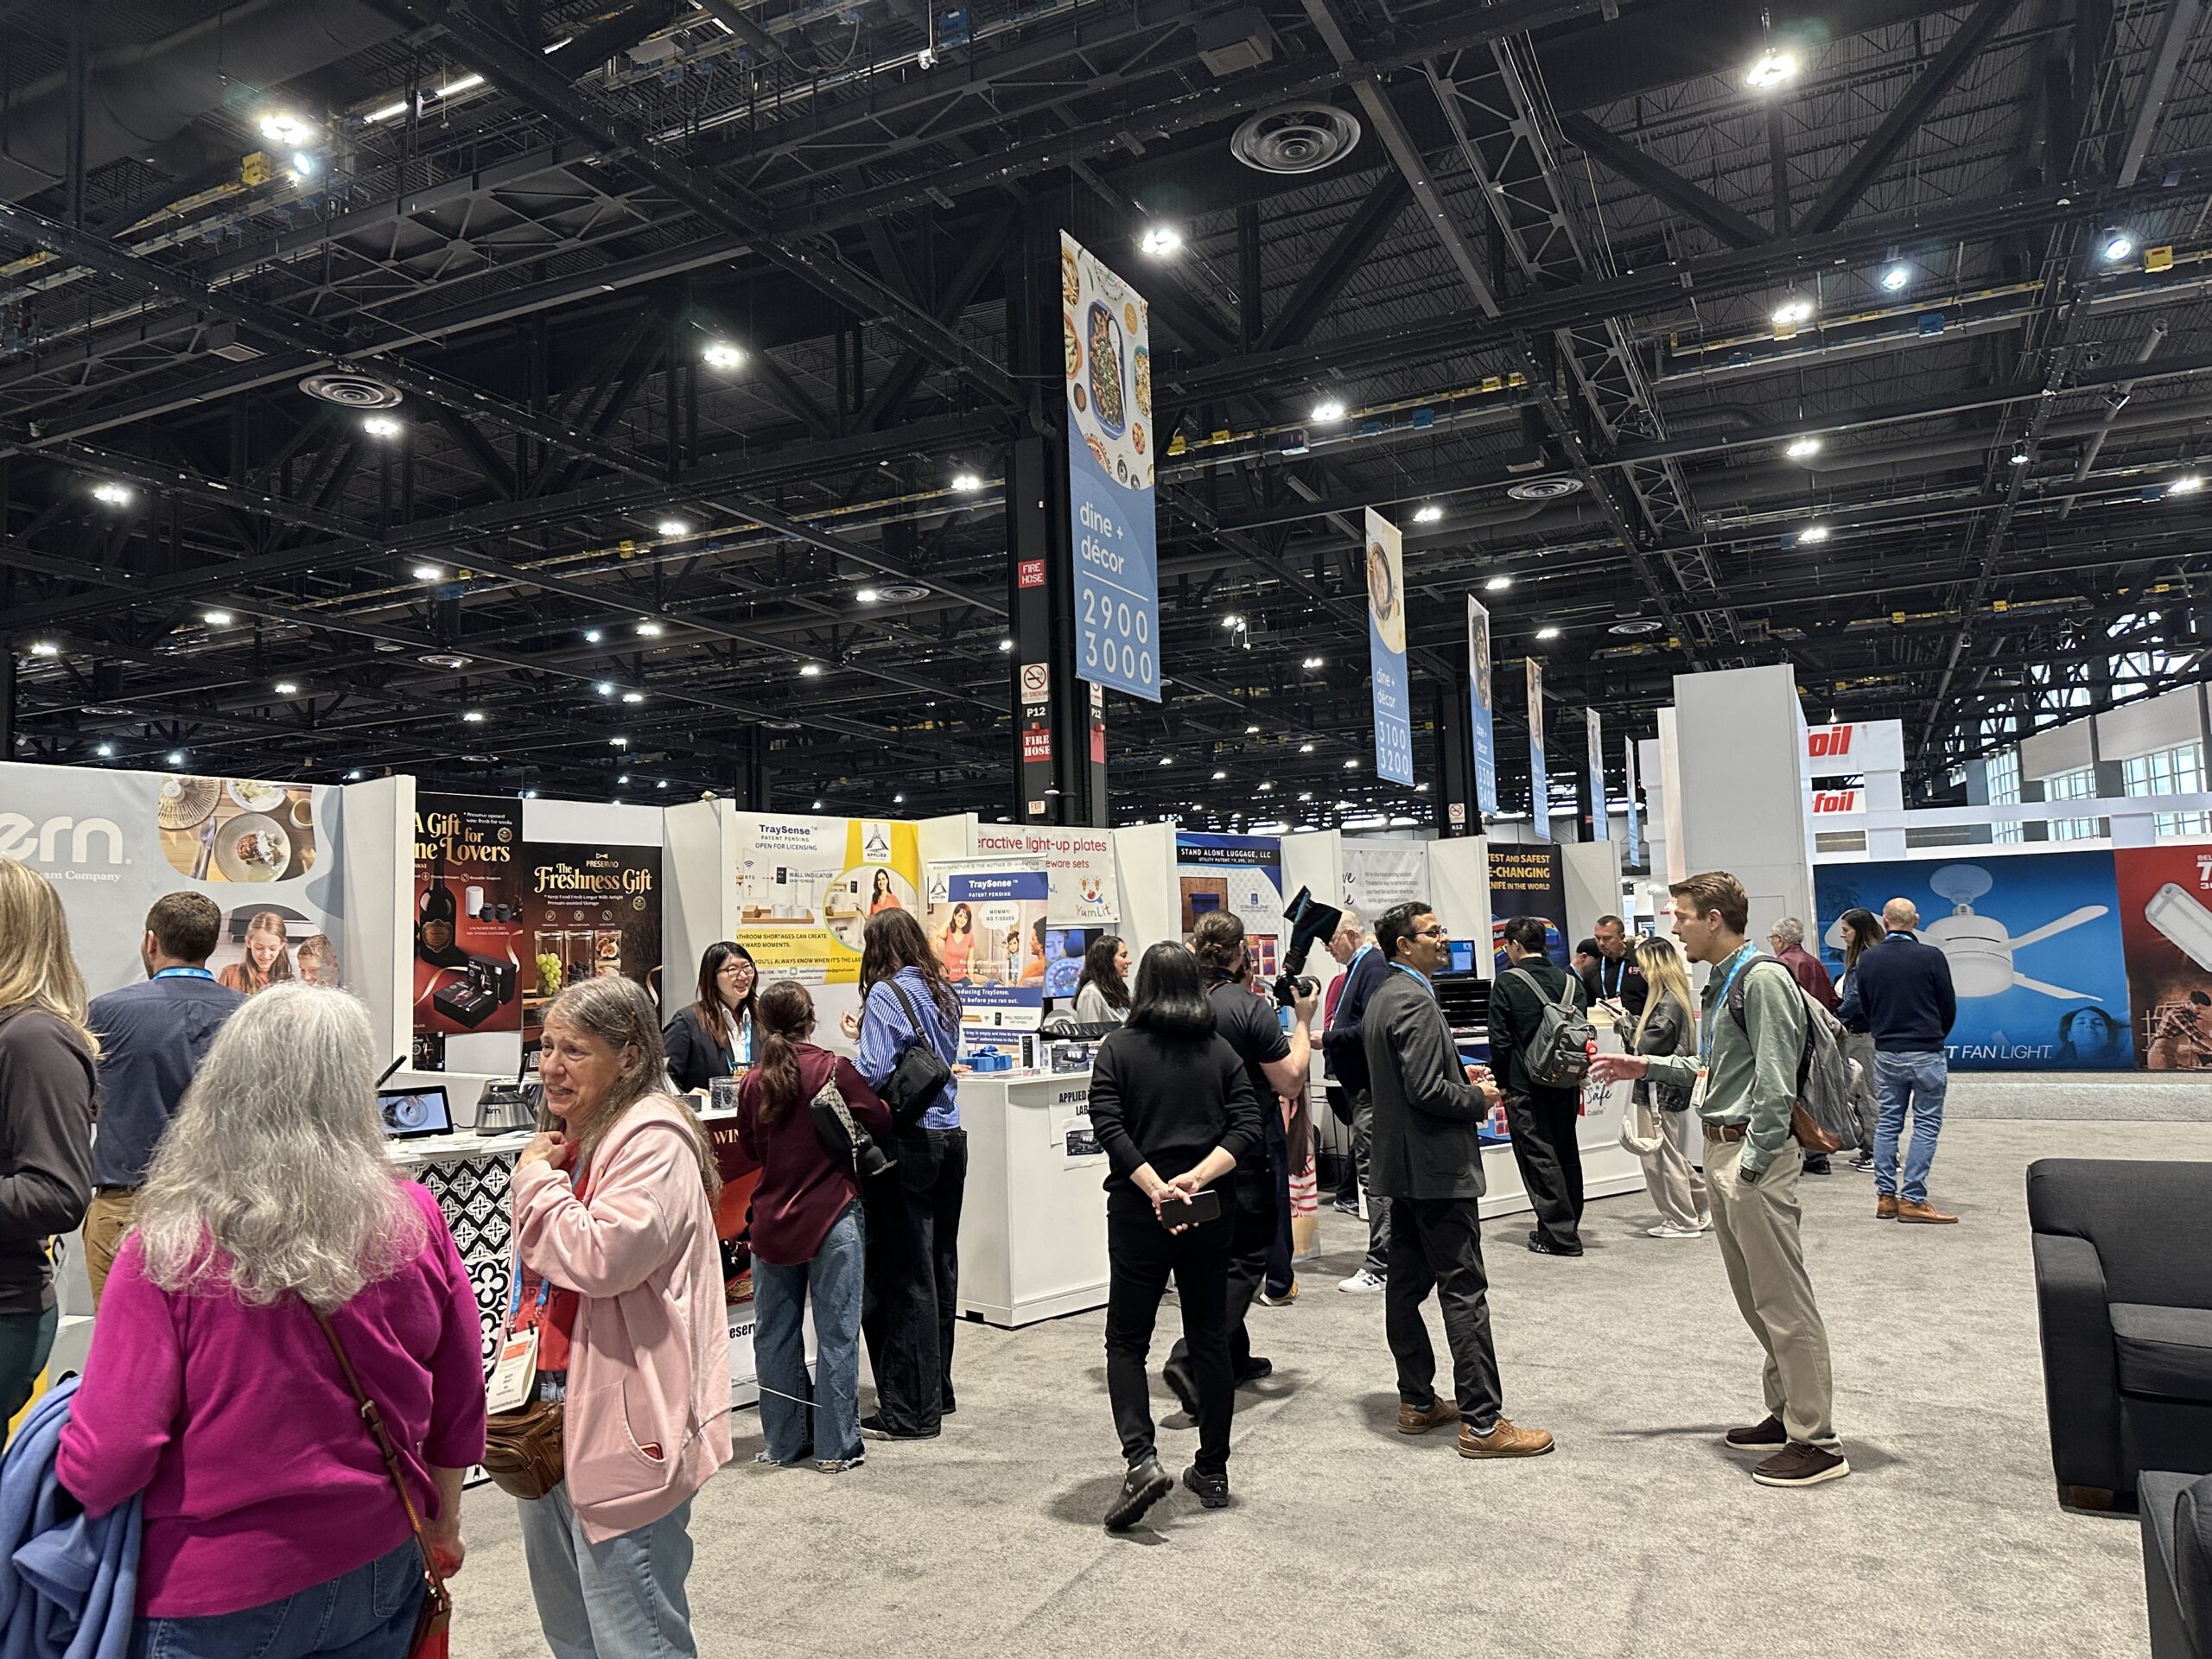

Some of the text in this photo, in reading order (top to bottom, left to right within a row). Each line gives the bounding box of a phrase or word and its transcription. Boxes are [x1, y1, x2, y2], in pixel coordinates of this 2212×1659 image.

[1080, 501, 1113, 538] dine
[1081, 535, 1125, 575] décor
[1023, 563, 1040, 574] FIRE
[1021, 573, 1043, 584] HOSE
[1083, 588, 1148, 645] 2900
[1085, 630, 1153, 685] 3000
[1376, 668, 1390, 687] dine
[1377, 689, 1396, 709] décor
[1027, 707, 1046, 717] P12
[1091, 708, 1102, 719] P12
[1025, 734, 1049, 746] FIRE
[1379, 720, 1406, 751] 3100
[1808, 725, 1853, 757] oil
[1024, 745, 1051, 757] HOSE
[1380, 747, 1408, 776] 3200
[1813, 791, 1855, 813] foil
[427, 812, 461, 838] Gift
[759, 824, 810, 835] TraySense
[465, 827, 484, 842] for
[439, 836, 511, 866] Lovers
[1027, 836, 1070, 853] light-up
[1073, 838, 1107, 854] plates
[1227, 850, 1258, 859] LUGGAGE,
[1521, 855, 1550, 863] SAFEST
[556, 862, 572, 874] The
[1072, 860, 1090, 868] sets
[66, 870, 121, 882] Company
[534, 867, 653, 894] Freshness Gift
[969, 880, 1012, 890] TraySense
[1490, 881, 1506, 890] NIFE
[1076, 904, 1111, 918] YumLit
[1961, 1046, 1997, 1059] FAN
[1059, 1090, 1086, 1103] APPLIED
[1586, 1084, 1612, 1106] Safe
